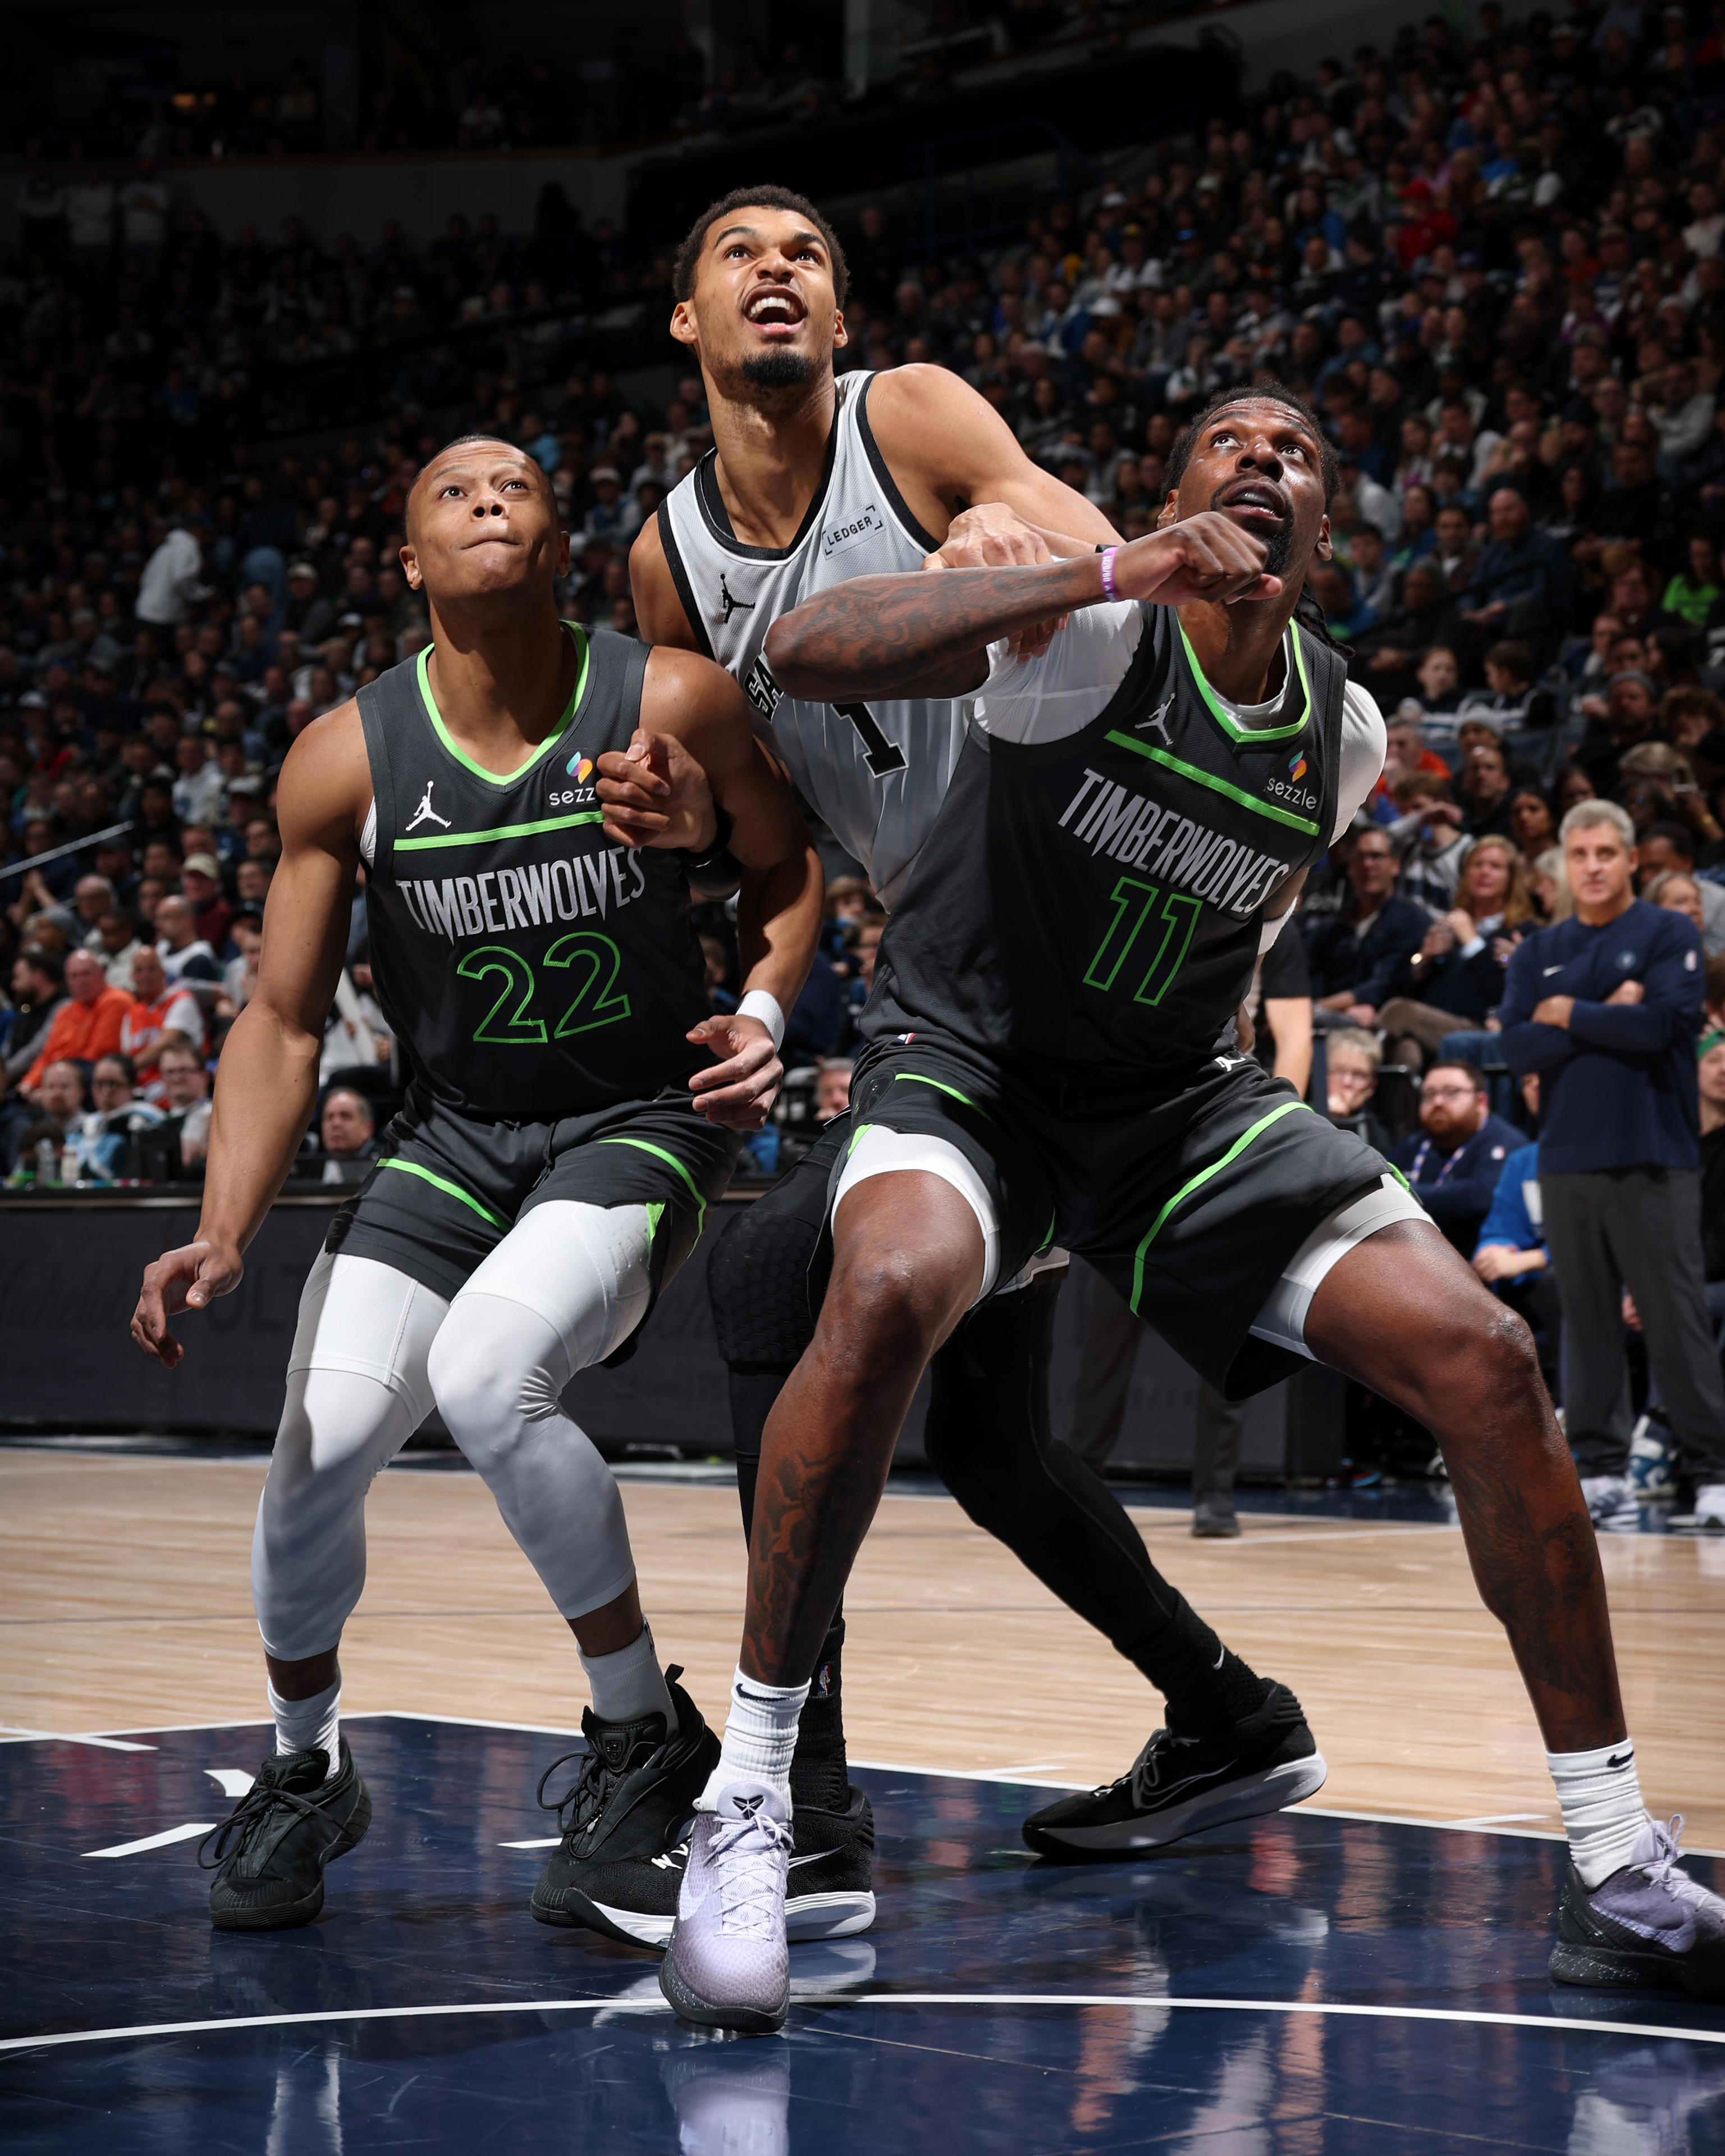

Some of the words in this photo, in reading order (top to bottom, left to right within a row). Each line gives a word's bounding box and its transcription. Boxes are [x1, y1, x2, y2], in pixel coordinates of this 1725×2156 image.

[827, 517, 872, 546] LEDGER
[744, 655, 784, 724] SA
[831, 702, 909, 778] 1
[549, 787, 596, 806] sezz
[1267, 778, 1317, 810] sezzle
[1058, 768, 1290, 914] TIMBERWOLVES
[396, 846, 646, 945] TIMBERWOLVES
[1082, 876, 1203, 1006] 11
[457, 931, 632, 1043] 22
